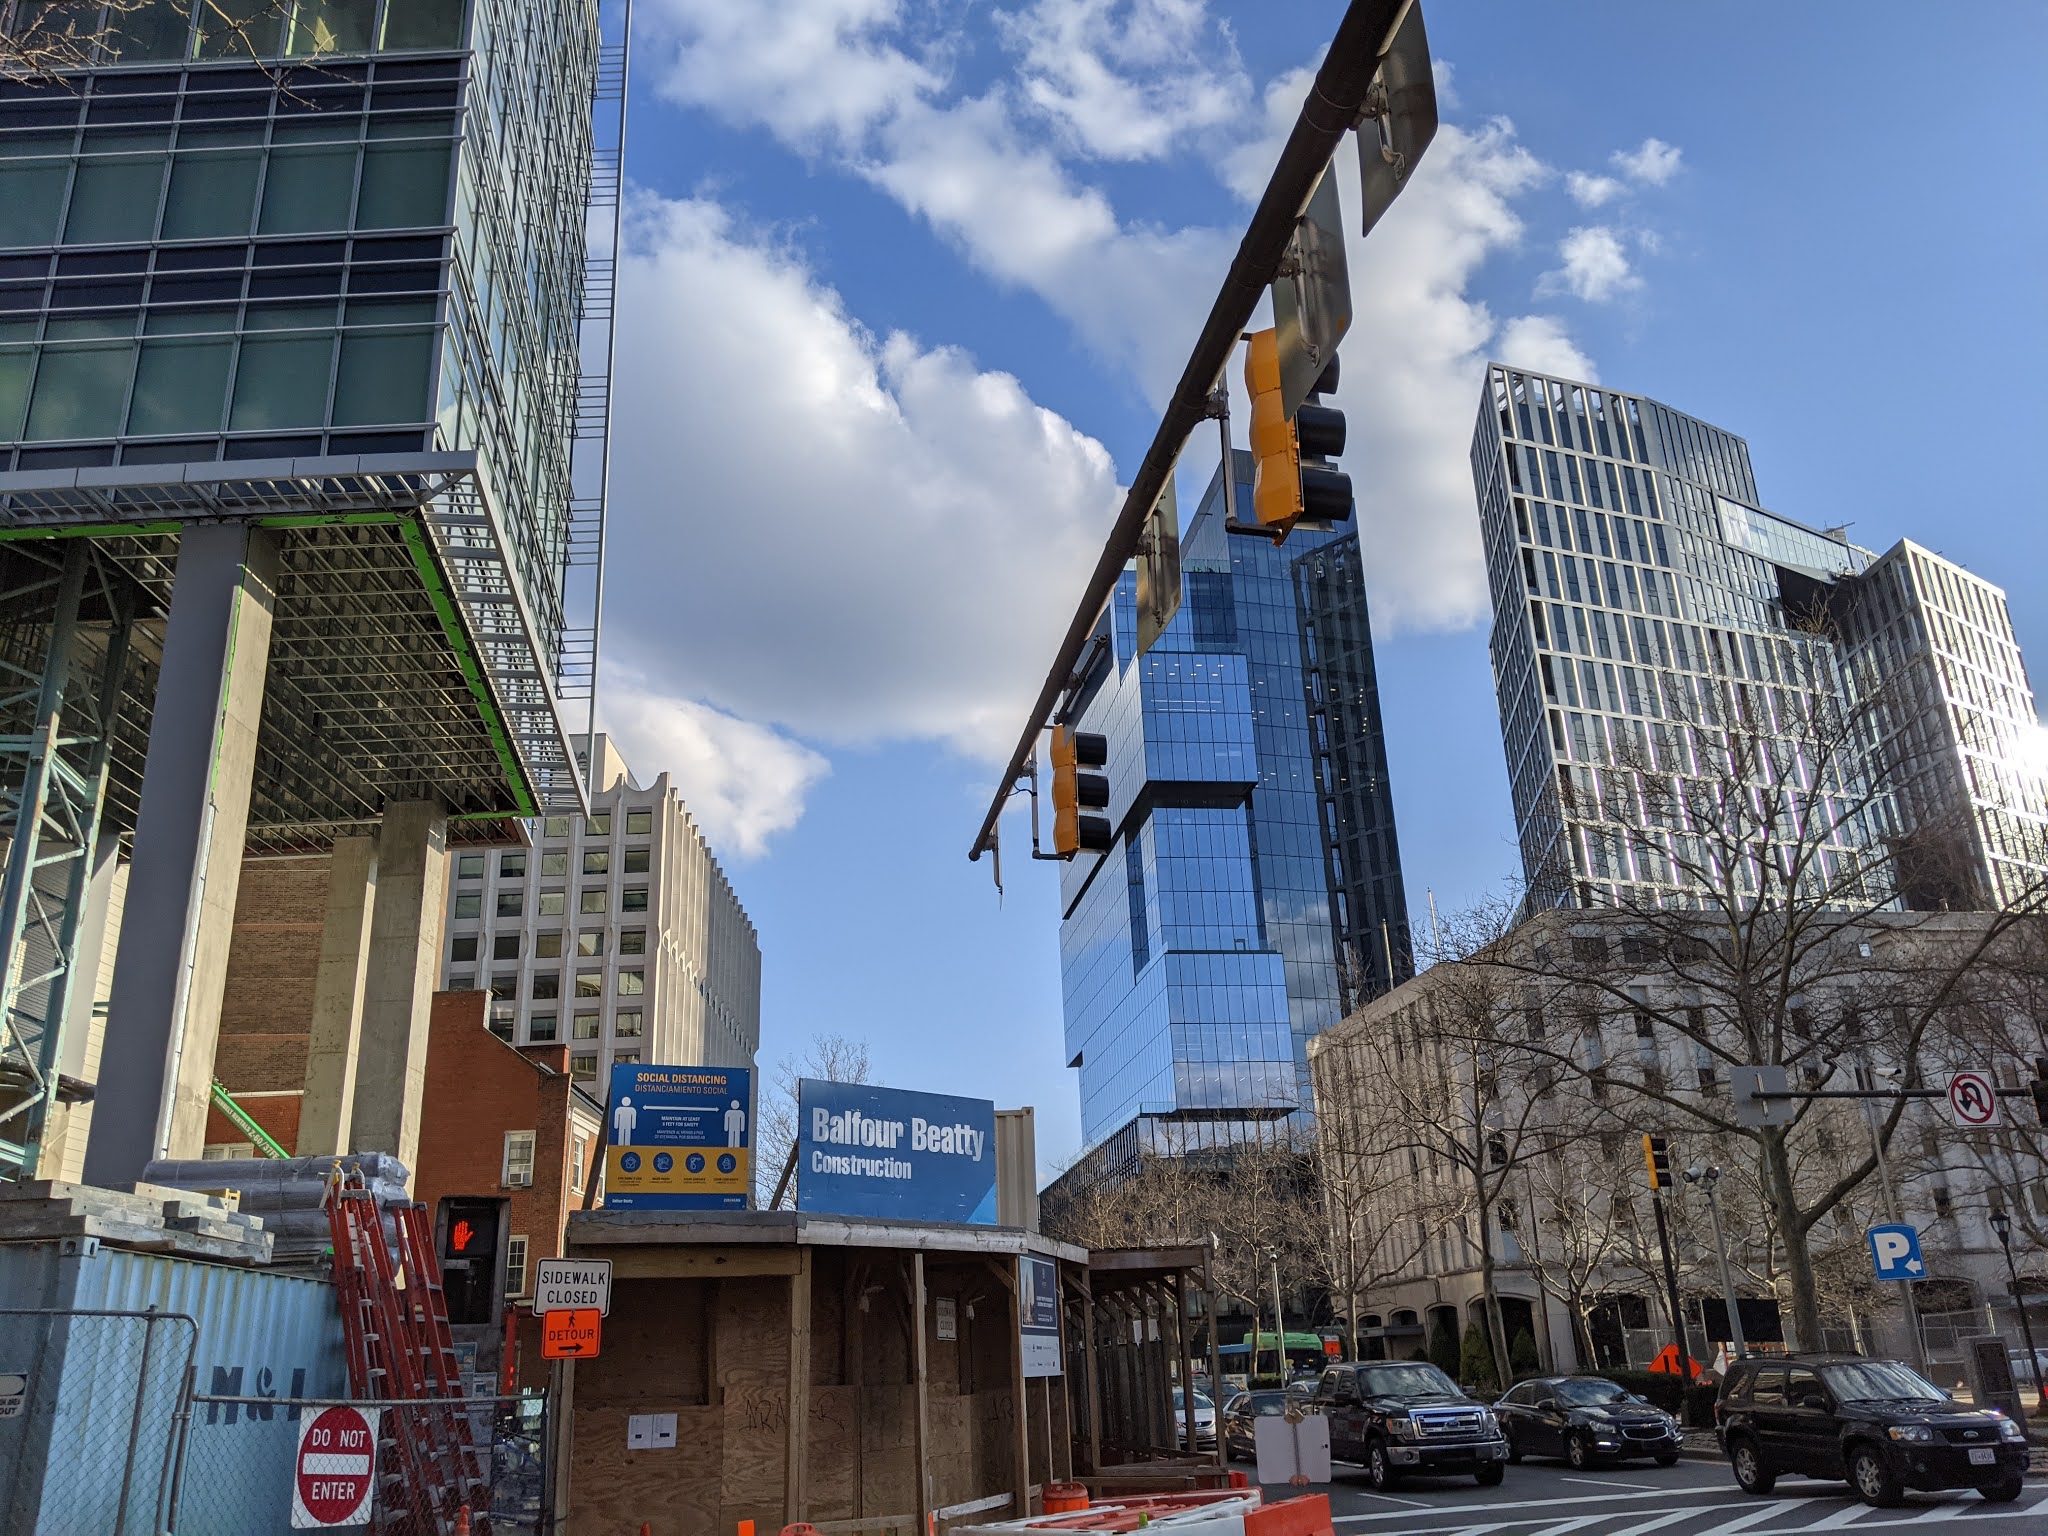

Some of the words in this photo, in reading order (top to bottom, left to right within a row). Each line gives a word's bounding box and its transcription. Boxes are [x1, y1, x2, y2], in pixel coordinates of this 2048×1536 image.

[637, 1073, 669, 1082] SOCIAL
[672, 1074, 727, 1085] DISTANCING
[635, 1085, 701, 1094] DISTANCIAMIENTO
[703, 1086, 728, 1095] SOCIAL
[812, 1107, 904, 1149] Balfour
[912, 1117, 984, 1162] Beatty
[812, 1150, 912, 1179] Construction
[1873, 1232, 1910, 1270] P
[542, 1271, 606, 1285] SIDEWALK
[547, 1290, 598, 1304] CLOSED
[548, 1328, 595, 1341] DETOUR
[312, 1428, 331, 1446] DO
[340, 1430, 366, 1447] NOT
[312, 1482, 355, 1500] ENTER
